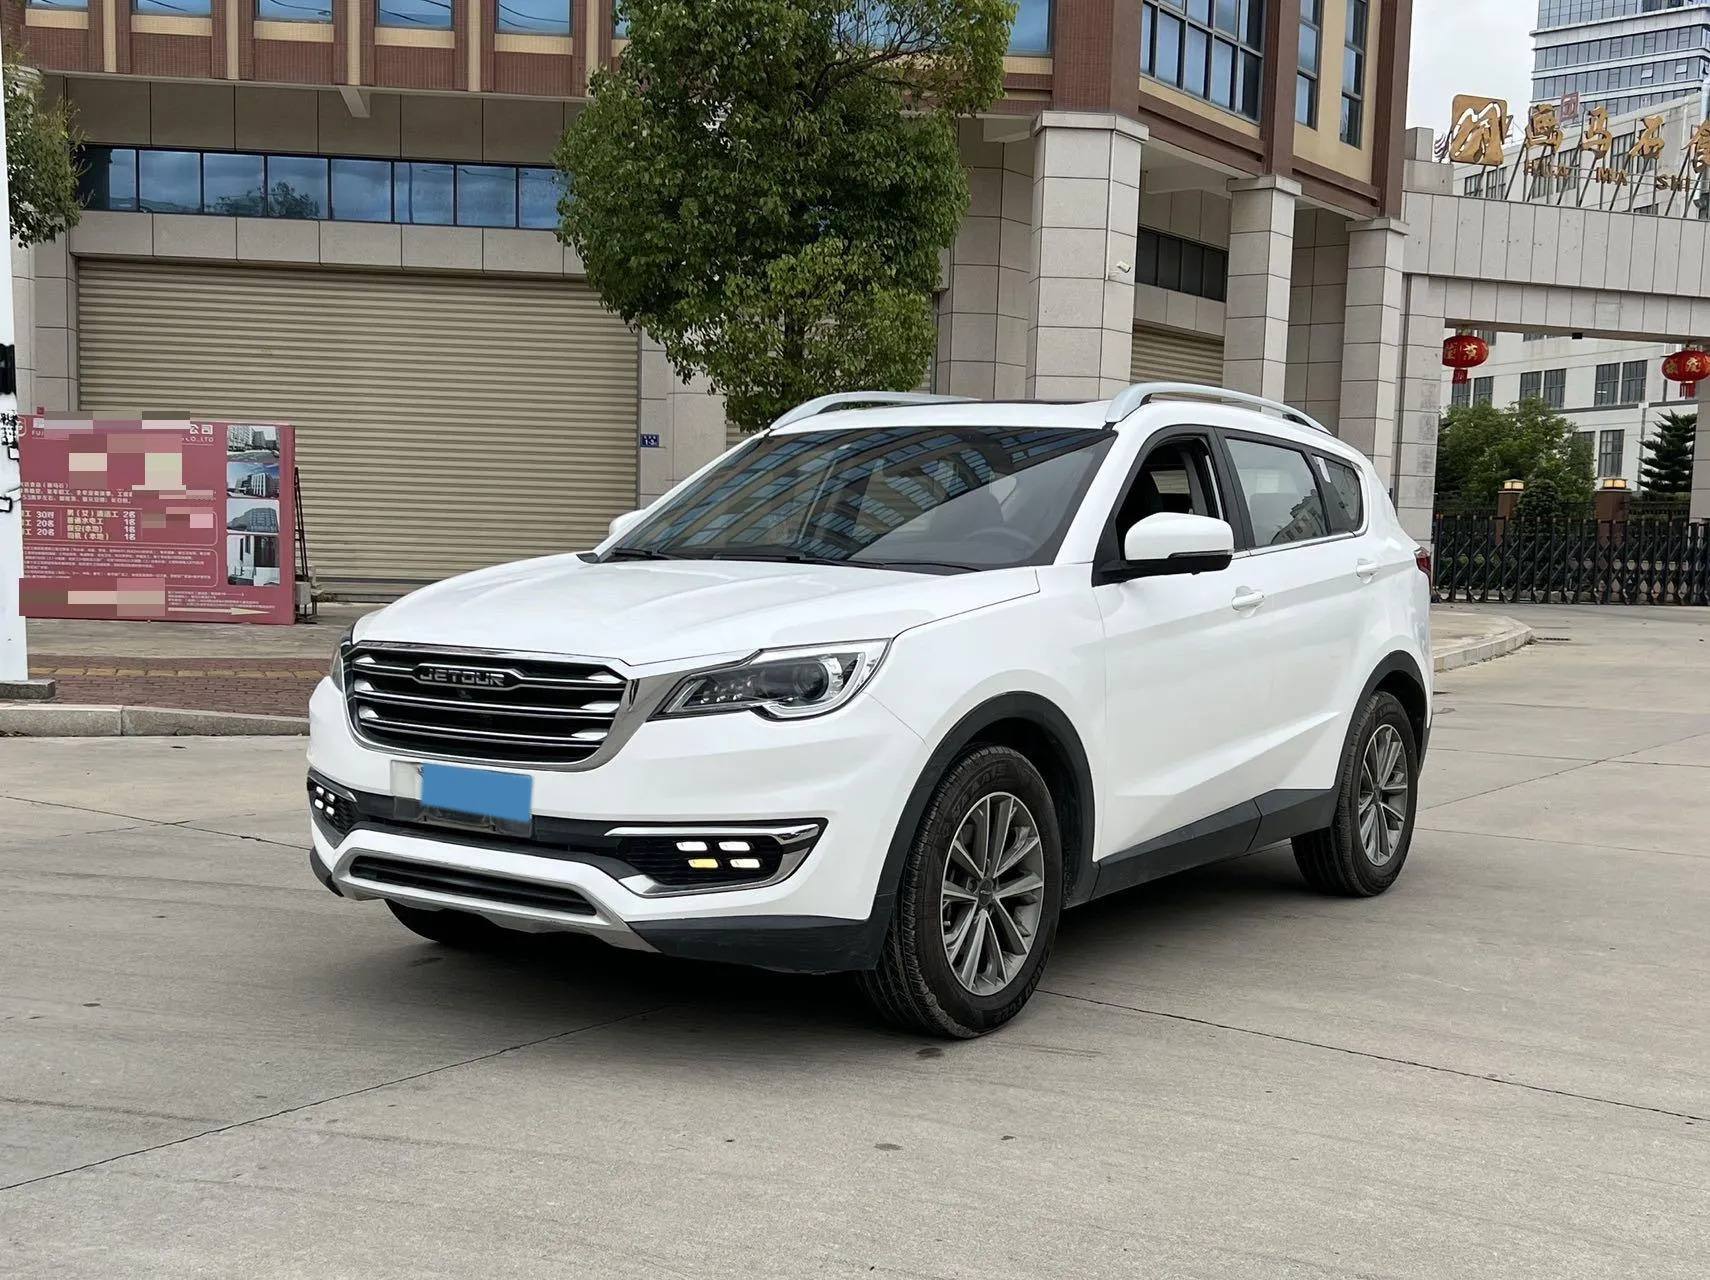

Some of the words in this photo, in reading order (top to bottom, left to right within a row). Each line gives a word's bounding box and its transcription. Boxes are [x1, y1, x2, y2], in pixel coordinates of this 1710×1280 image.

[1596, 167, 1628, 186] MA
[1655, 174, 1690, 191] SHI
[420, 668, 504, 687] JETOUR
